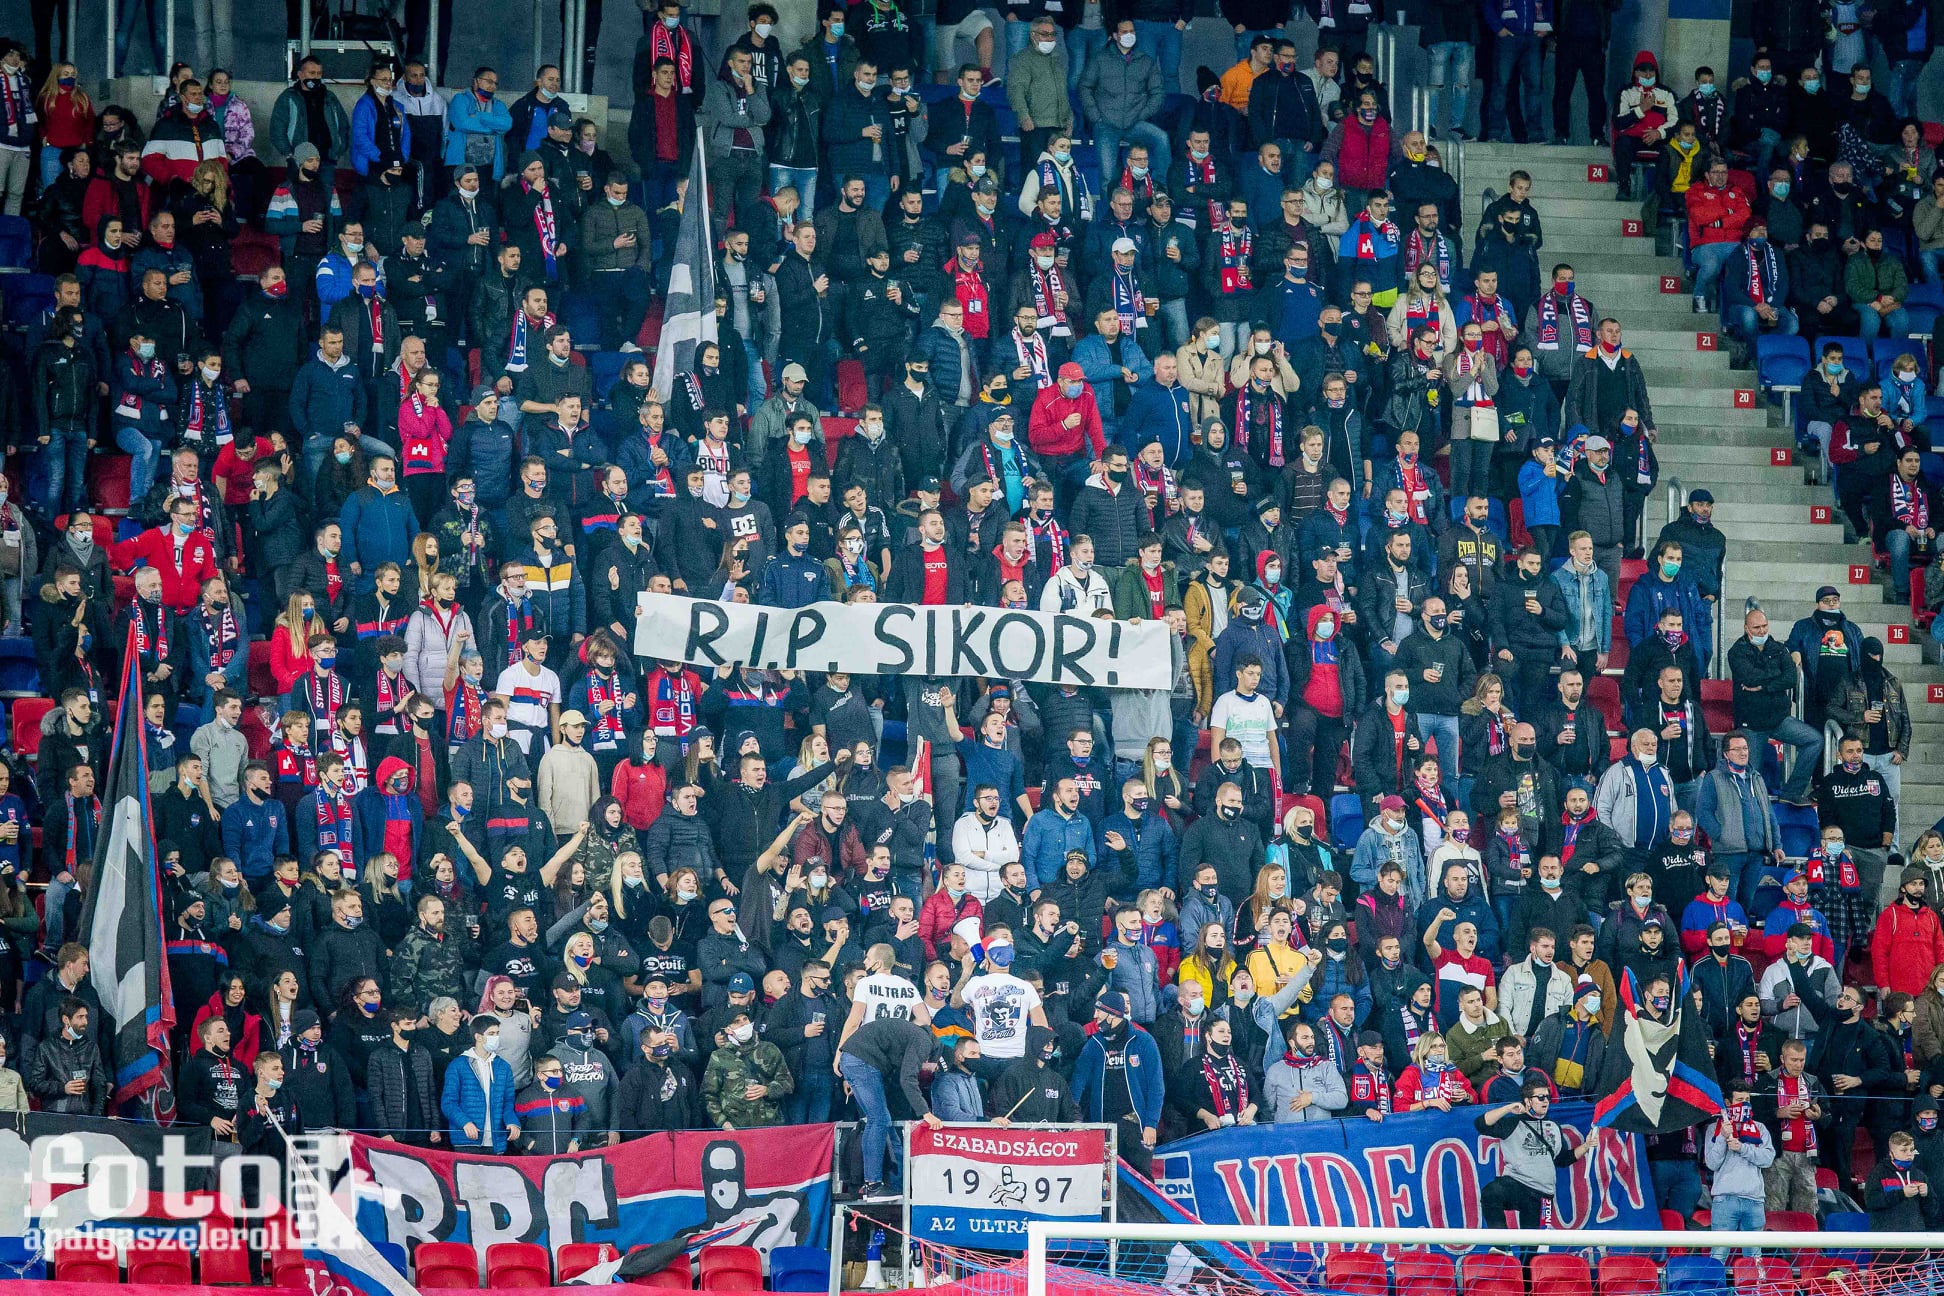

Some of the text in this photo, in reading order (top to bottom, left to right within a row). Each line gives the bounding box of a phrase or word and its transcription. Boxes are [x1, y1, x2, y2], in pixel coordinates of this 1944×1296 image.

[1592, 168, 1603, 178] 24
[1628, 222, 1638, 233] 23
[1665, 279, 1675, 289] 22
[1702, 336, 1712, 346] 21
[1739, 393, 1749, 403] 20
[1776, 451, 1786, 461] 19
[1815, 509, 1825, 519] 18
[1854, 568, 1864, 579] 17
[1893, 629, 1903, 639] 16
[685, 601, 1120, 686] R.I.P. SIKOR!
[1933, 687, 1944, 698] 15
[1774, 743, 1784, 754] 14
[846, 794, 875, 802] ellesse
[643, 957, 687, 971] Devils
[868, 984, 915, 998] ULTRAS
[933, 1132, 1078, 1158] SZABADSÁGOT
[942, 1168, 1073, 1203] 19 97
[1214, 1124, 1645, 1257] VIDEOON
[930, 1217, 956, 1232] AZ
